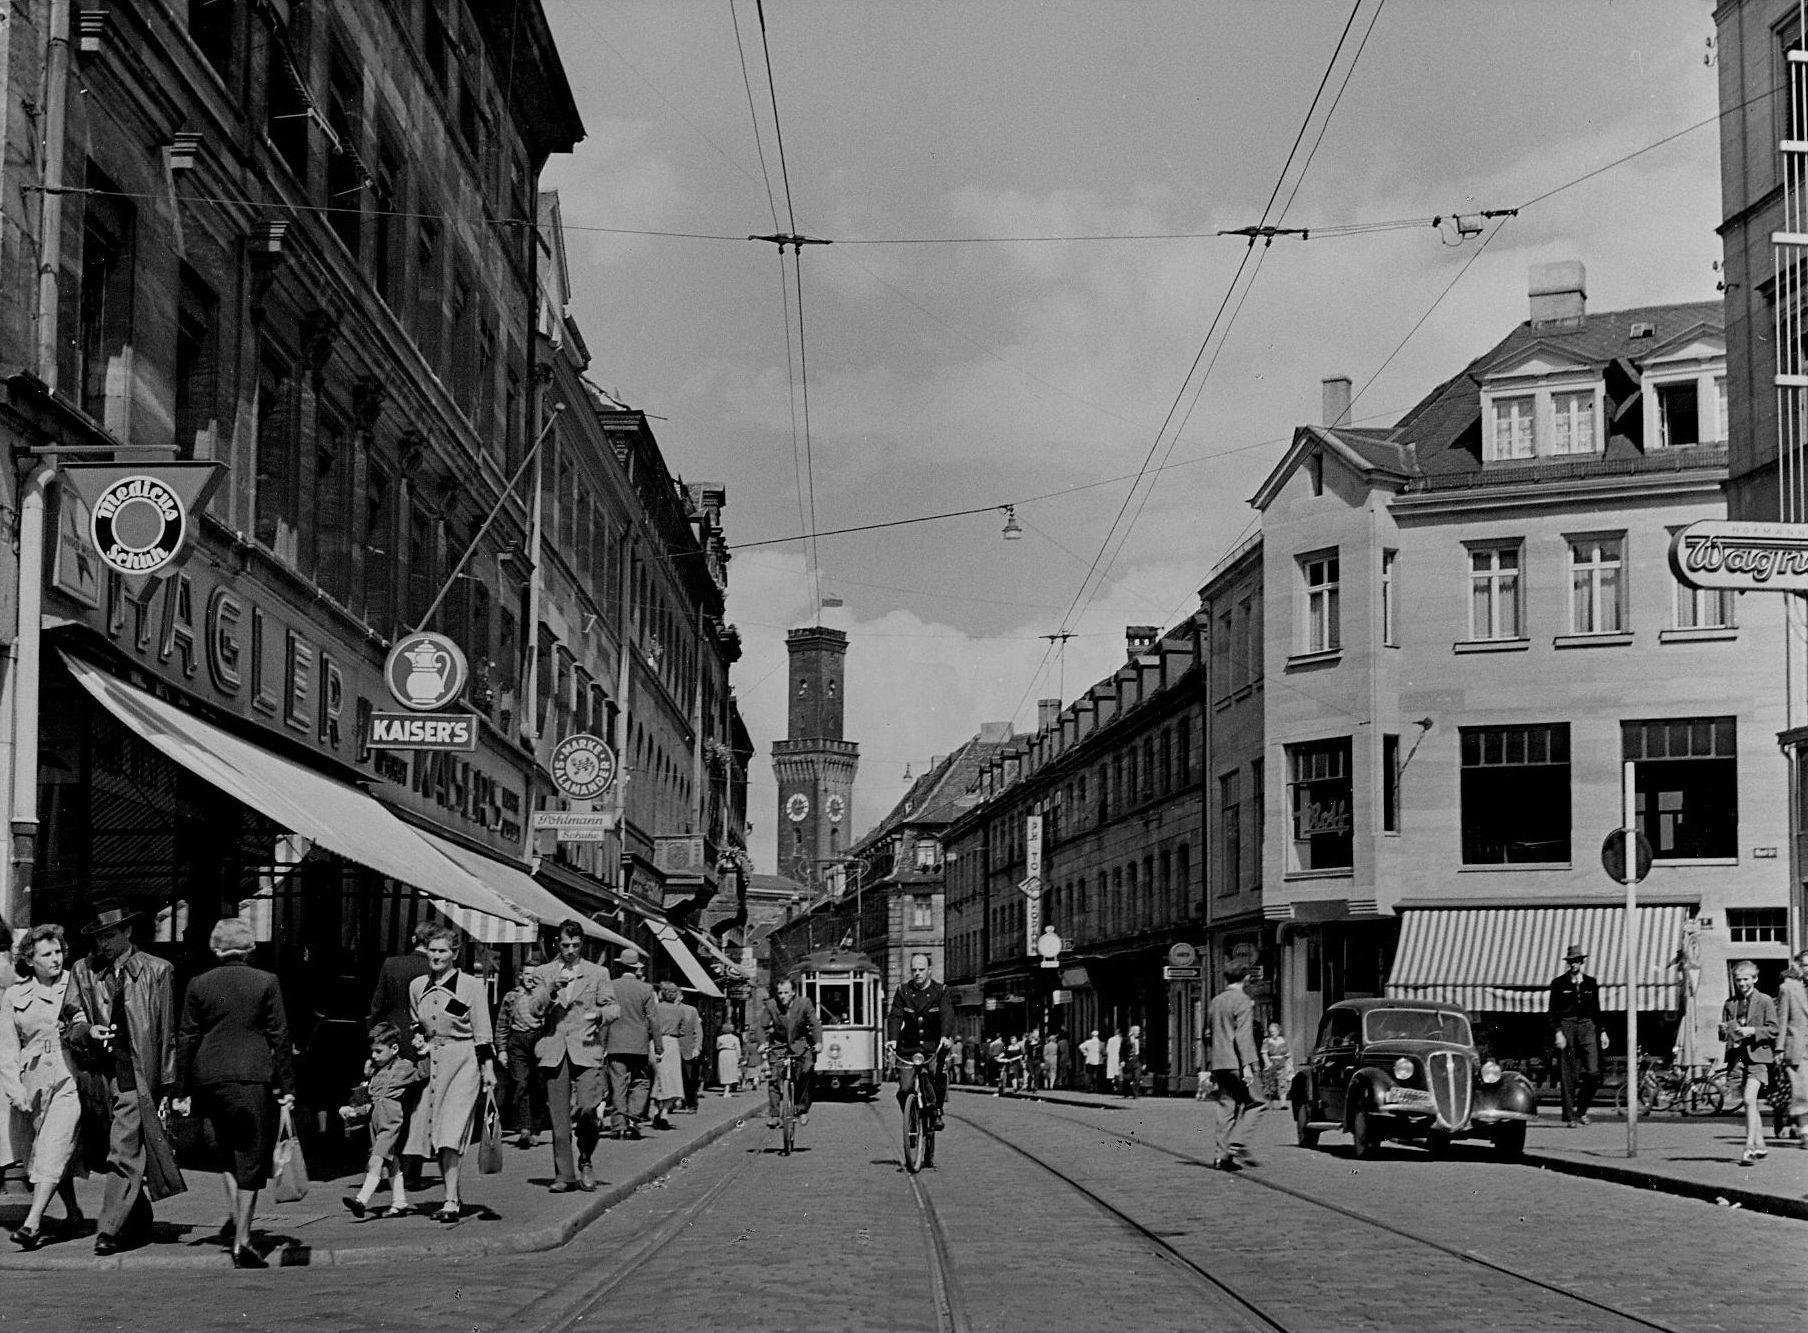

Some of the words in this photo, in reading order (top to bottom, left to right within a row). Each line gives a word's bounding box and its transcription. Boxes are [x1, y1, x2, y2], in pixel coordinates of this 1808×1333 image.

[1685, 536, 1808, 582] Wagn
[373, 719, 469, 743] KAISER'S
[561, 739, 604, 756] MARKE
[554, 760, 611, 795] SALAMANDER
